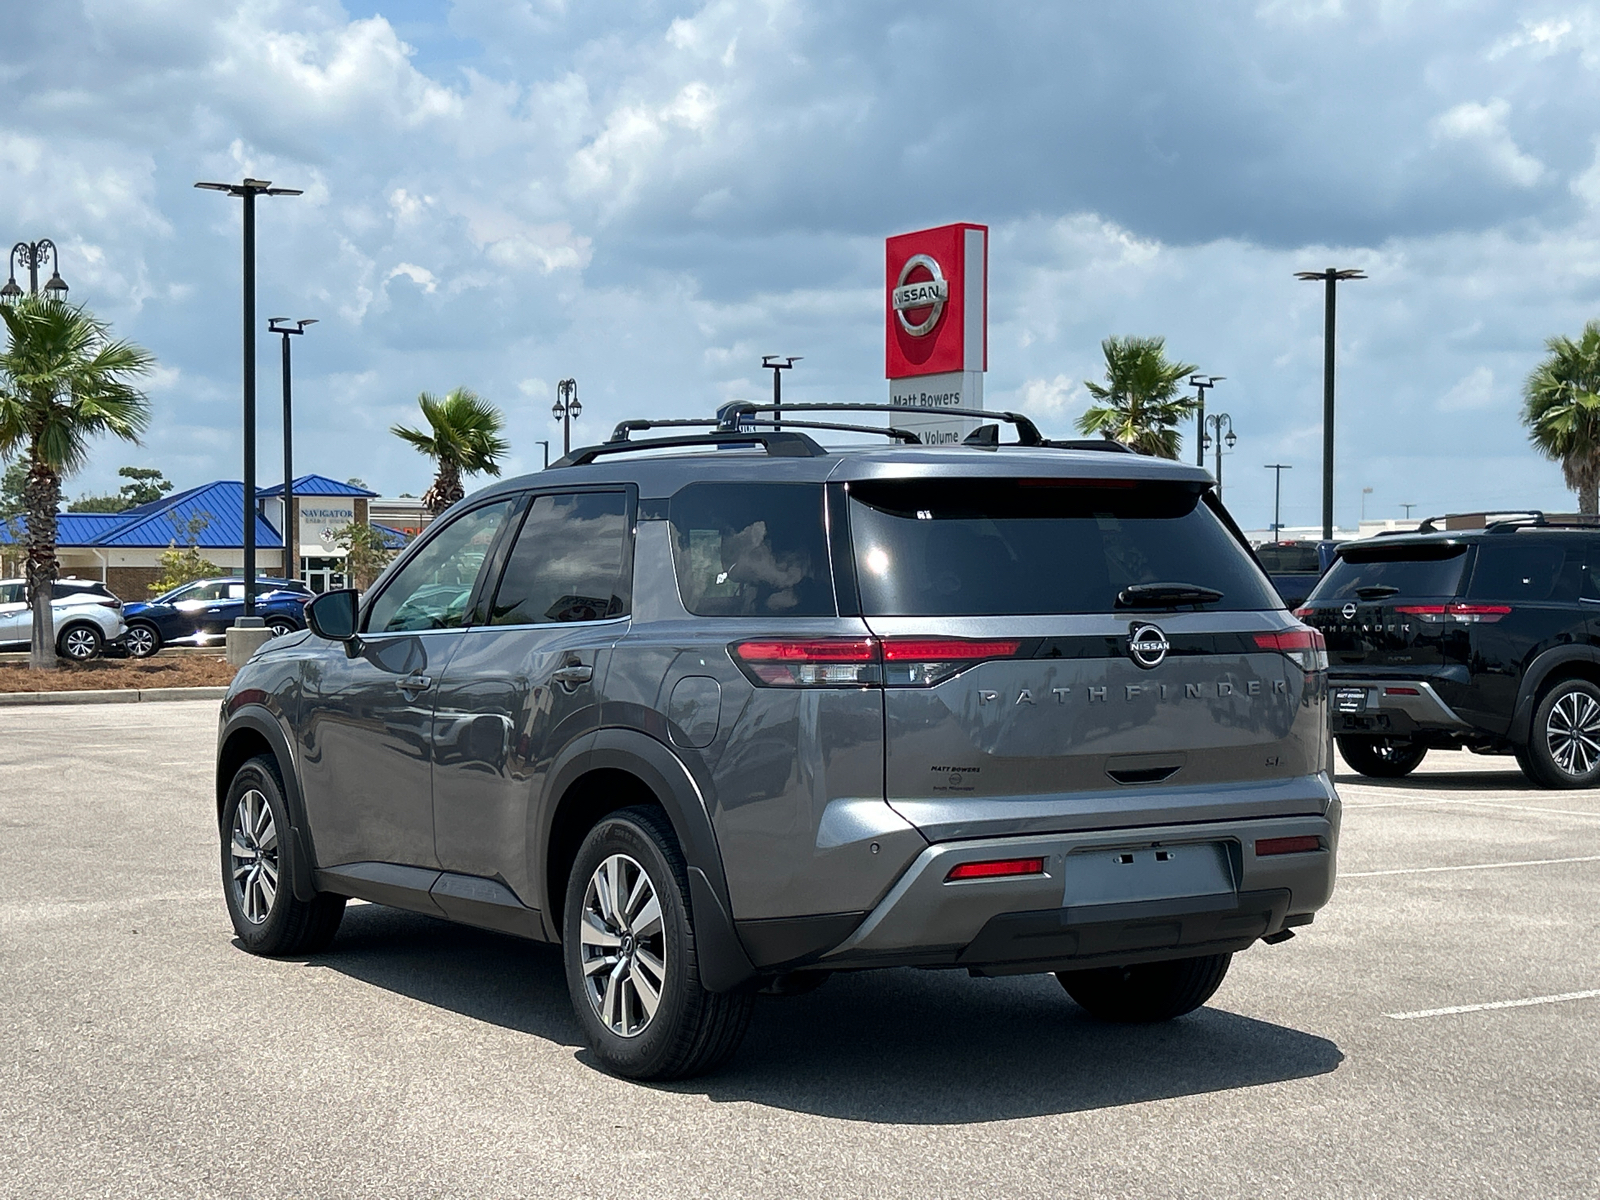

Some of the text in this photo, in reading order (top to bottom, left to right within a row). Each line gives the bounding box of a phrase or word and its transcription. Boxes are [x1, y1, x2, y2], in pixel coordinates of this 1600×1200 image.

[894, 284, 940, 305] NISSAN
[893, 391, 960, 407] Matt Bowers
[924, 430, 959, 445] Volume
[301, 509, 354, 518] NAVIGATOR
[1319, 624, 1410, 634] THFINDER
[1130, 642, 1170, 651] NISSAN
[977, 679, 1287, 707] PATHFINDER
